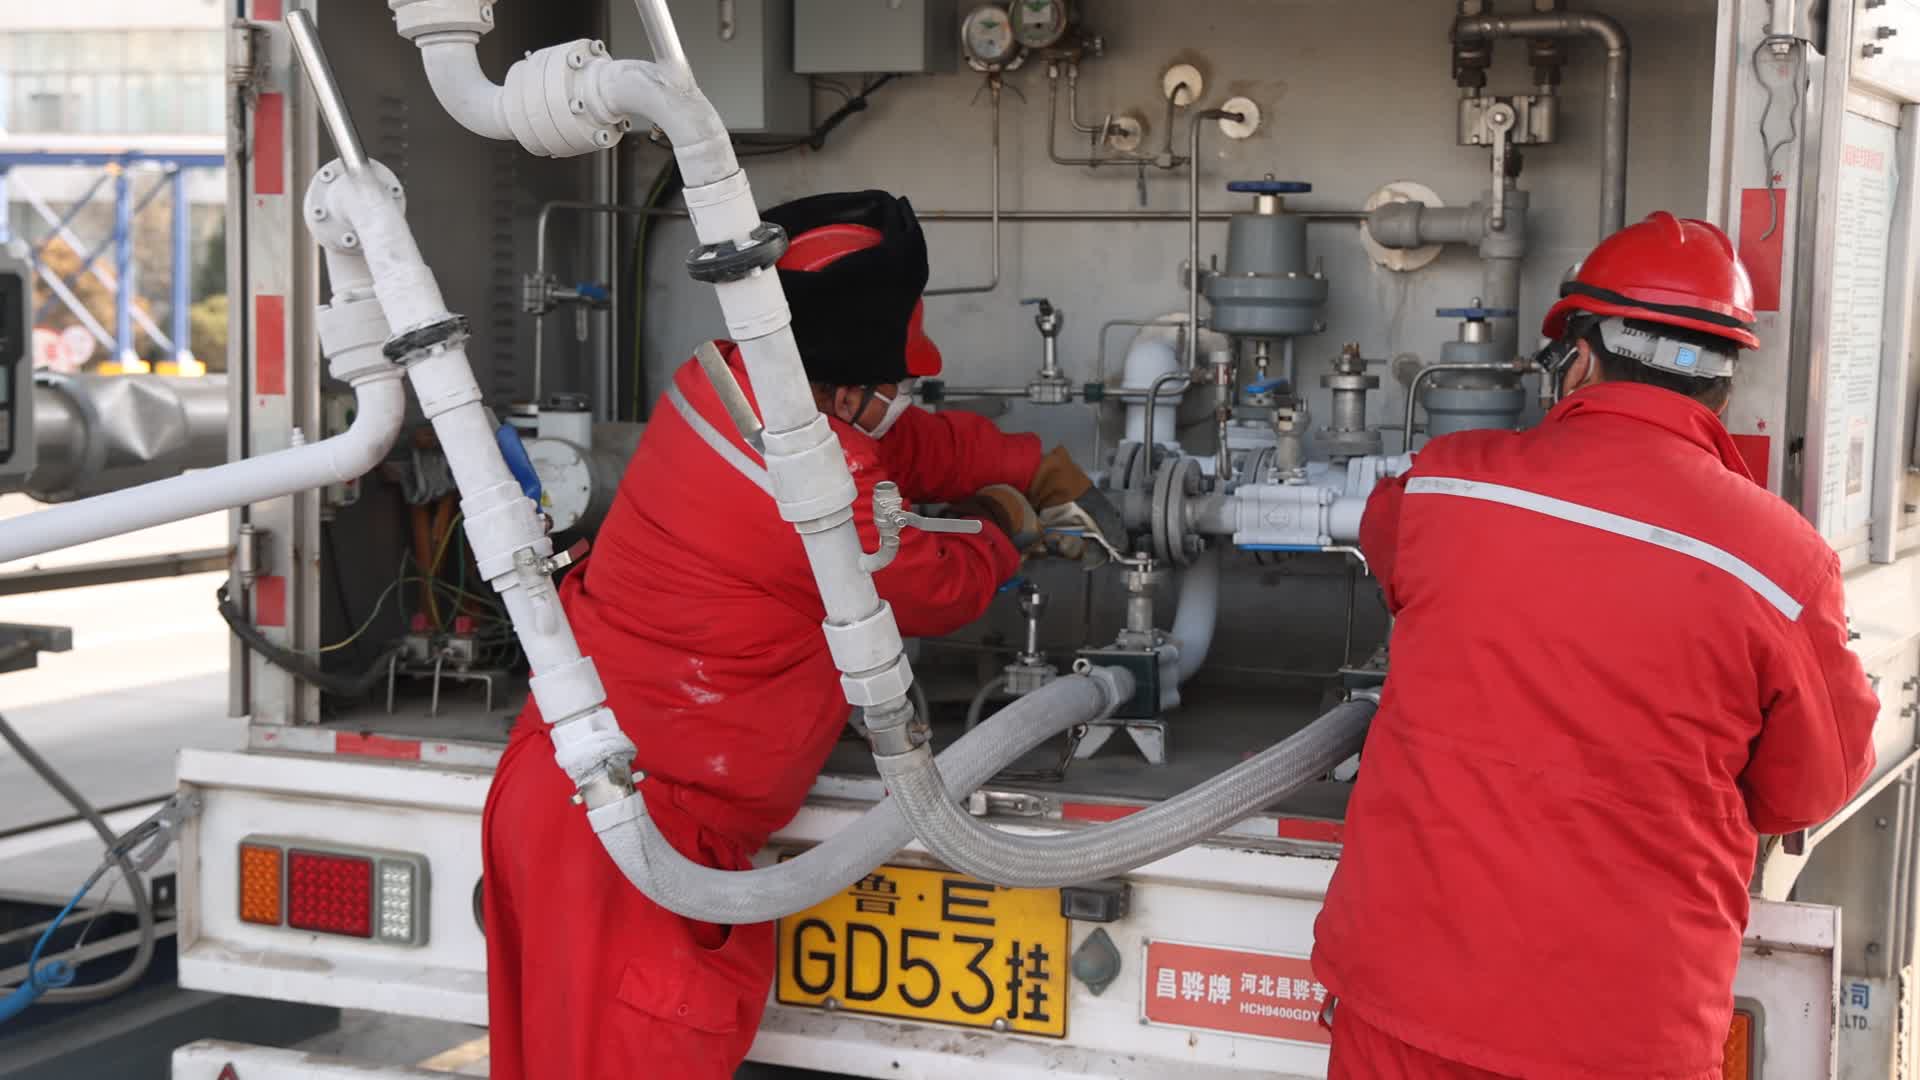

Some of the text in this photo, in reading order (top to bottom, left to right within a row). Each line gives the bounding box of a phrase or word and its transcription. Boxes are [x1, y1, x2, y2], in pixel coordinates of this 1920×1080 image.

[793, 918, 1050, 1023] GD53挂
[1156, 967, 1232, 1006] 昌骅牌
